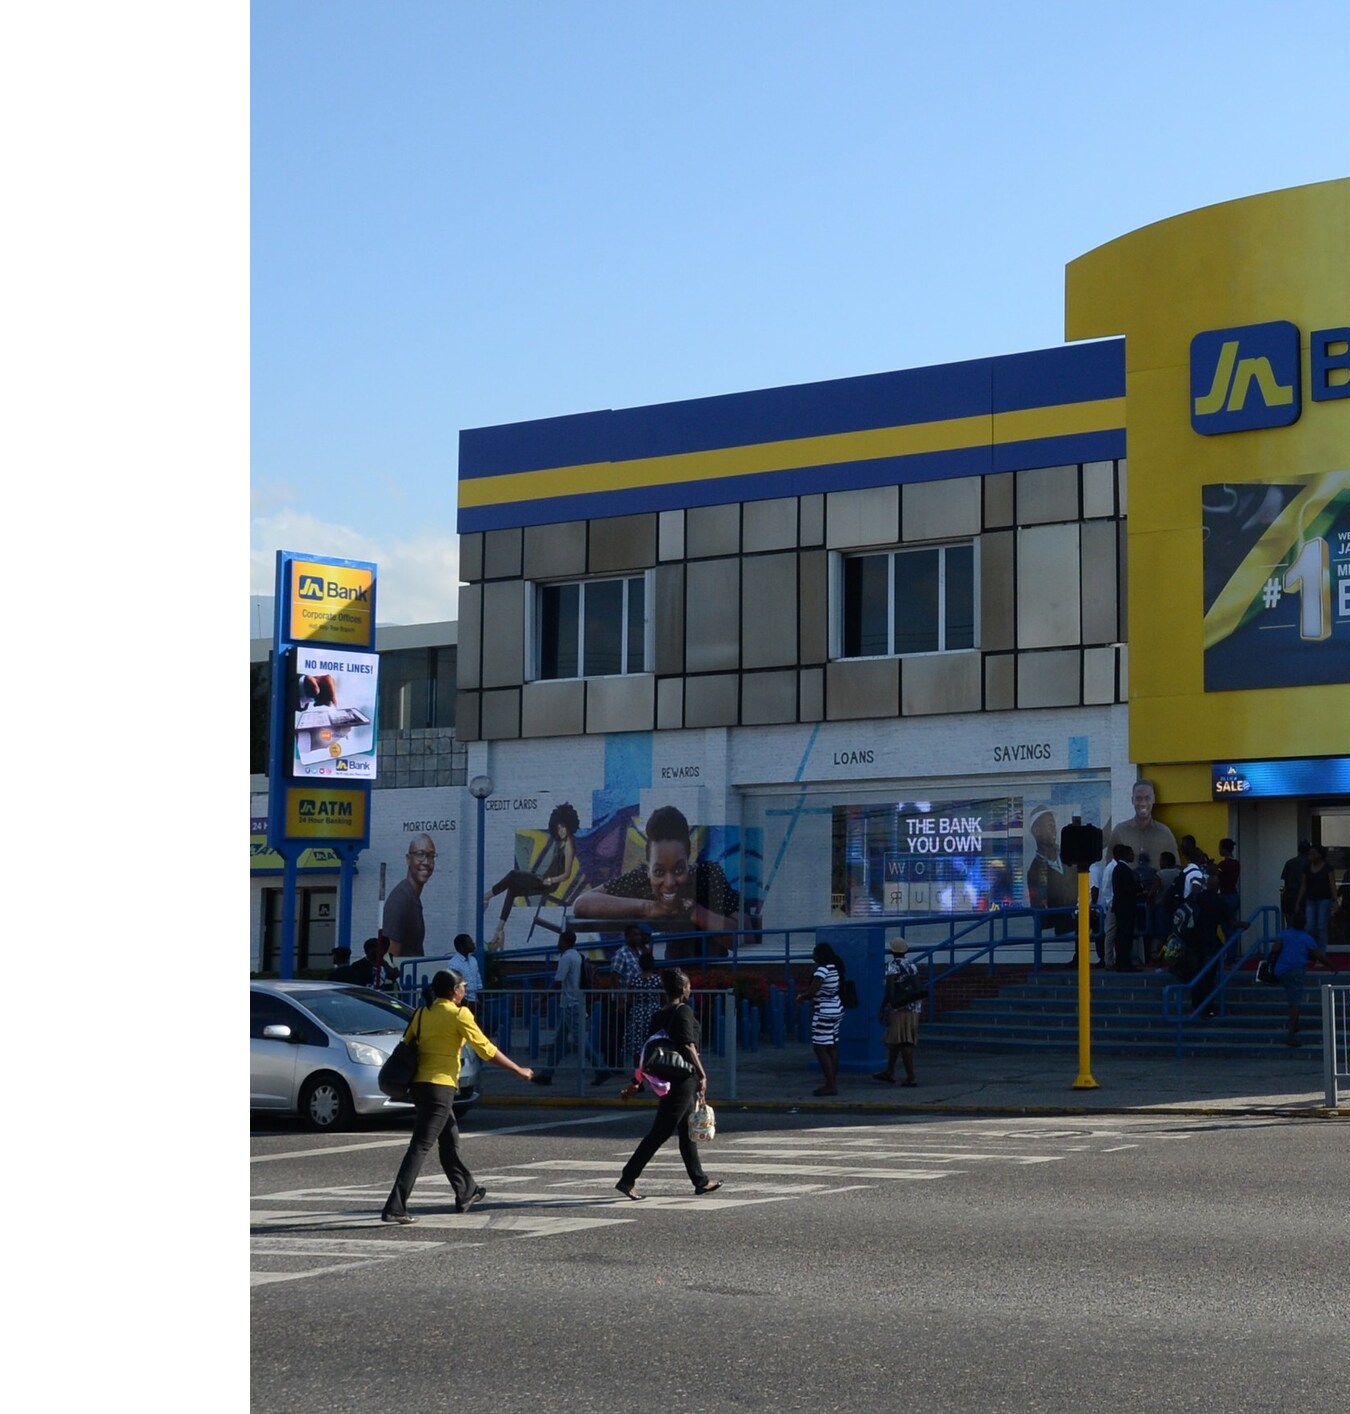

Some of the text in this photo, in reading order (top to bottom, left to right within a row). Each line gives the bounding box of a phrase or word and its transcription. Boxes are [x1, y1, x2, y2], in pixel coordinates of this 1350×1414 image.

[327, 581, 367, 602] Bank
[302, 609, 338, 621] Corporate
[304, 659, 374, 675] NO MORE LINES!
[833, 750, 875, 765] LOANS
[993, 743, 1051, 762] SAVINGS
[349, 761, 370, 770] Bank
[661, 766, 700, 779] REWARDS
[1215, 780, 1243, 793] SALE
[318, 802, 353, 816] ATM
[485, 799, 538, 811] CREDIT CARDS
[403, 820, 456, 832] MORTGAGES
[905, 817, 983, 834] THE BANK
[907, 836, 983, 853] YOU OWN
